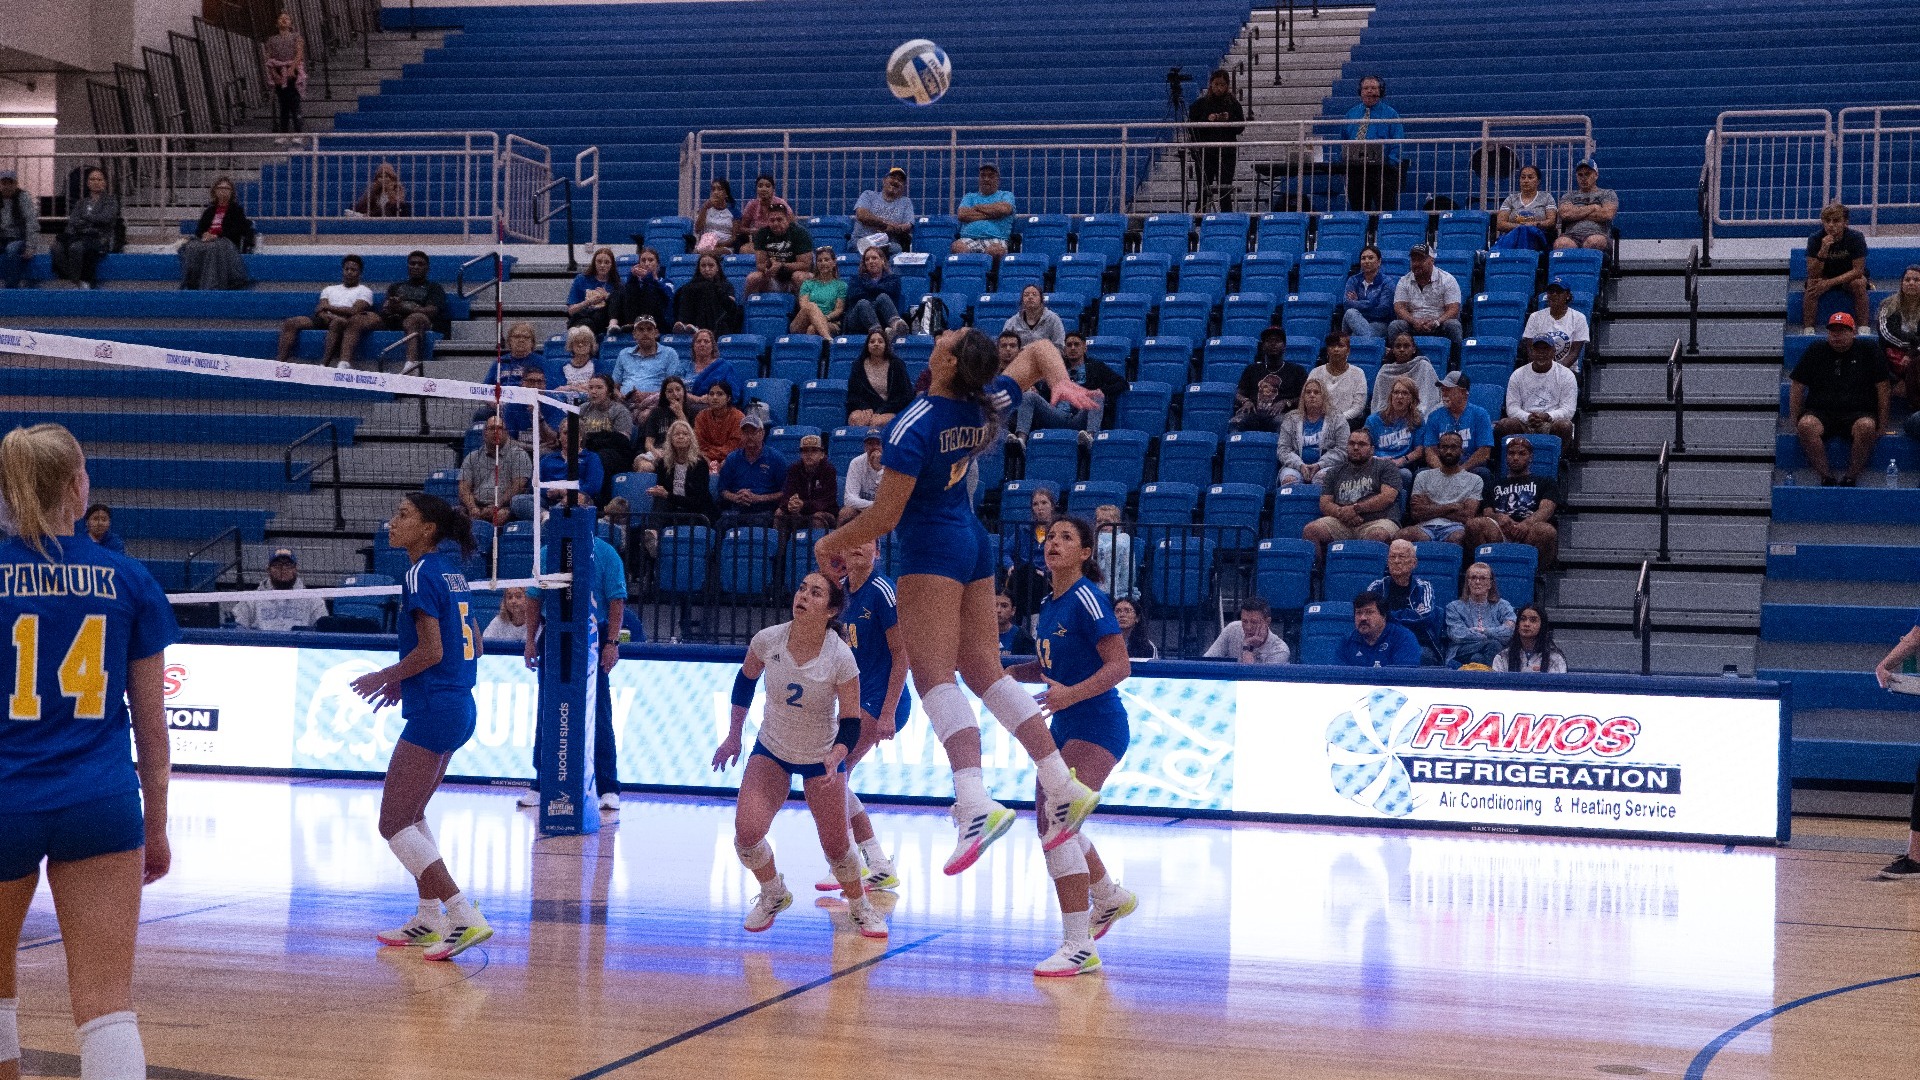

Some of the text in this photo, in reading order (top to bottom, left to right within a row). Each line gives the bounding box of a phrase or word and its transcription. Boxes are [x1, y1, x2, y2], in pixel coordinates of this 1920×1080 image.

[940, 424, 988, 454] TAMU
[1494, 481, 1537, 500] Aaliyah
[0, 564, 117, 599] TAMUK
[458, 602, 474, 660] 5
[9, 613, 108, 720] 14
[786, 683, 804, 708] 2
[557, 702, 569, 781] sports imports
[1410, 703, 1641, 757] RAMOS
[1412, 760, 1668, 789] REFRIGERATION
[1439, 791, 1677, 820] Air Conditioning & Heating Service
